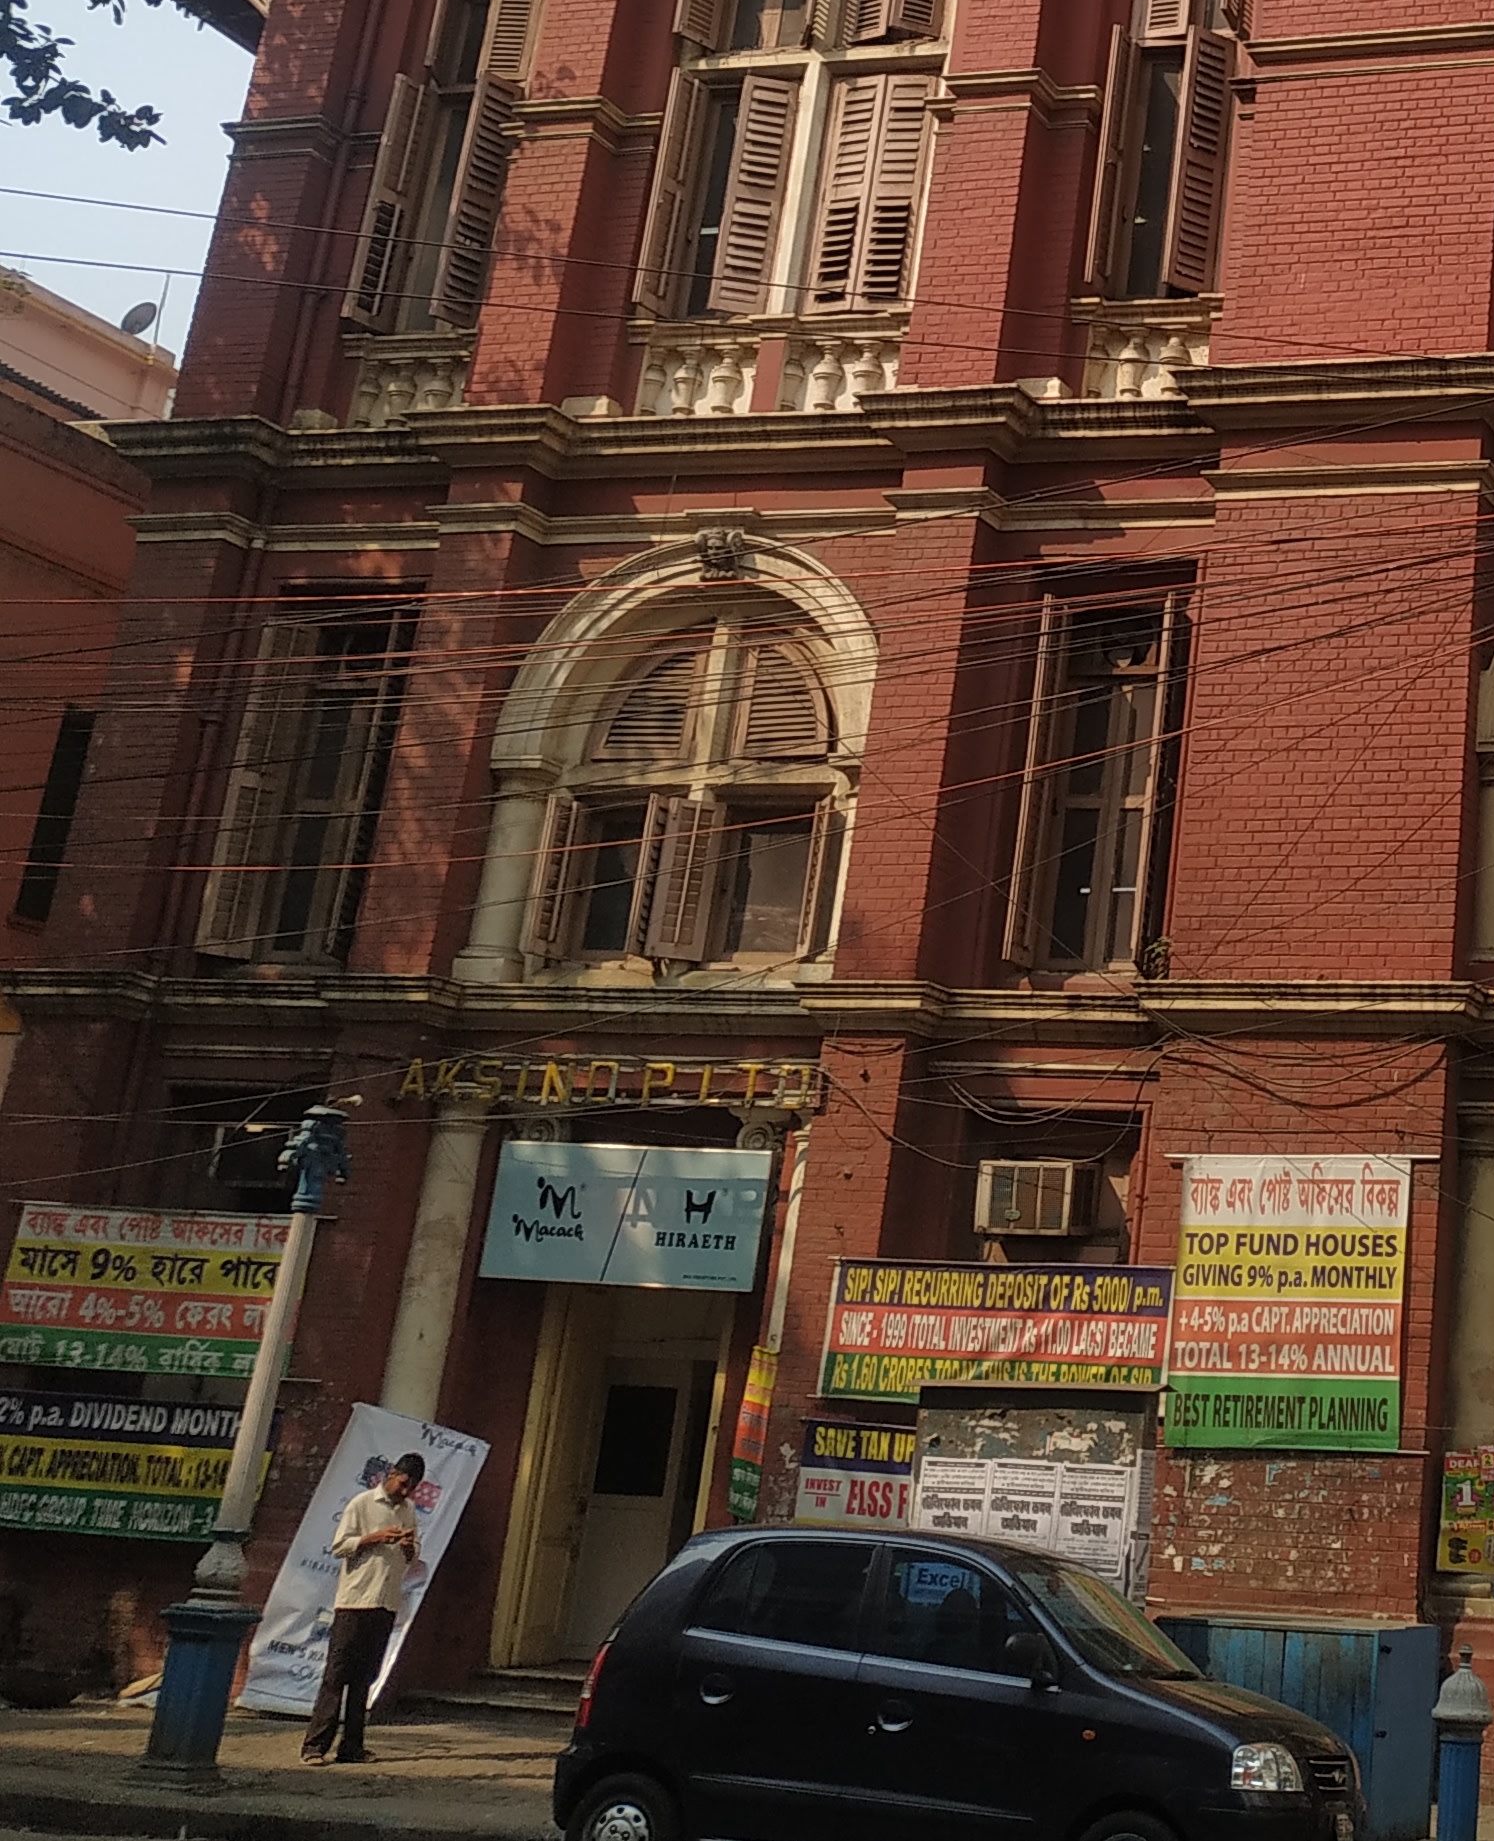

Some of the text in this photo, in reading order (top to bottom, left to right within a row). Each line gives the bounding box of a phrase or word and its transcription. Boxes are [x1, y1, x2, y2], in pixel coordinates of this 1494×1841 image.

[1226, 1178, 1253, 1214] এবং
[1297, 1162, 1355, 1215] অফিসের
[1360, 1162, 1400, 1217] বিকল্প
[655, 1231, 737, 1251] HIRAETH
[1185, 1232, 1398, 1257] TOP FUND HOUSES
[19, 1245, 81, 1278] মাসে
[90, 1248, 137, 1282] 9%
[151, 1253, 209, 1286] হারে
[1183, 1264, 1397, 1292] GIVING 9% p.a. MONTHLY
[844, 1267, 872, 1303] SIP!
[874, 1269, 901, 1304] SIP!
[902, 1270, 984, 1307] RECURRING
[985, 1273, 1047, 1309] DEPOSIT
[1051, 1275, 1071, 1310] OF
[1071, 1275, 1090, 1311] Rs
[1133, 1284, 1164, 1312] p.m.
[79, 1292, 165, 1329] 4%-5%
[1227, 1312, 1248, 1339] p.a
[1292, 1308, 1394, 1336] APPRECIATION
[838, 1311, 874, 1346] SINCE
[880, 1312, 907, 1348] 1999
[947, 1316, 1023, 1353] INVESTMENT
[1108, 1322, 1158, 1358] BECAME
[851, 1355, 878, 1390] 1.60
[1174, 1341, 1395, 1372] TOTAL 13-14% ANNUAL
[27, 1405, 64, 1431] p.a.
[69, 1401, 168, 1433] DIVIDEND
[170, 1407, 242, 1438] MONTH
[1173, 1393, 1388, 1432] BEST RETIREMENT PLANNING
[814, 1426, 857, 1459] SAVE
[805, 1478, 842, 1508] INVEST IN
[846, 1479, 893, 1518] ELSS
[917, 1568, 966, 1590] Excel
